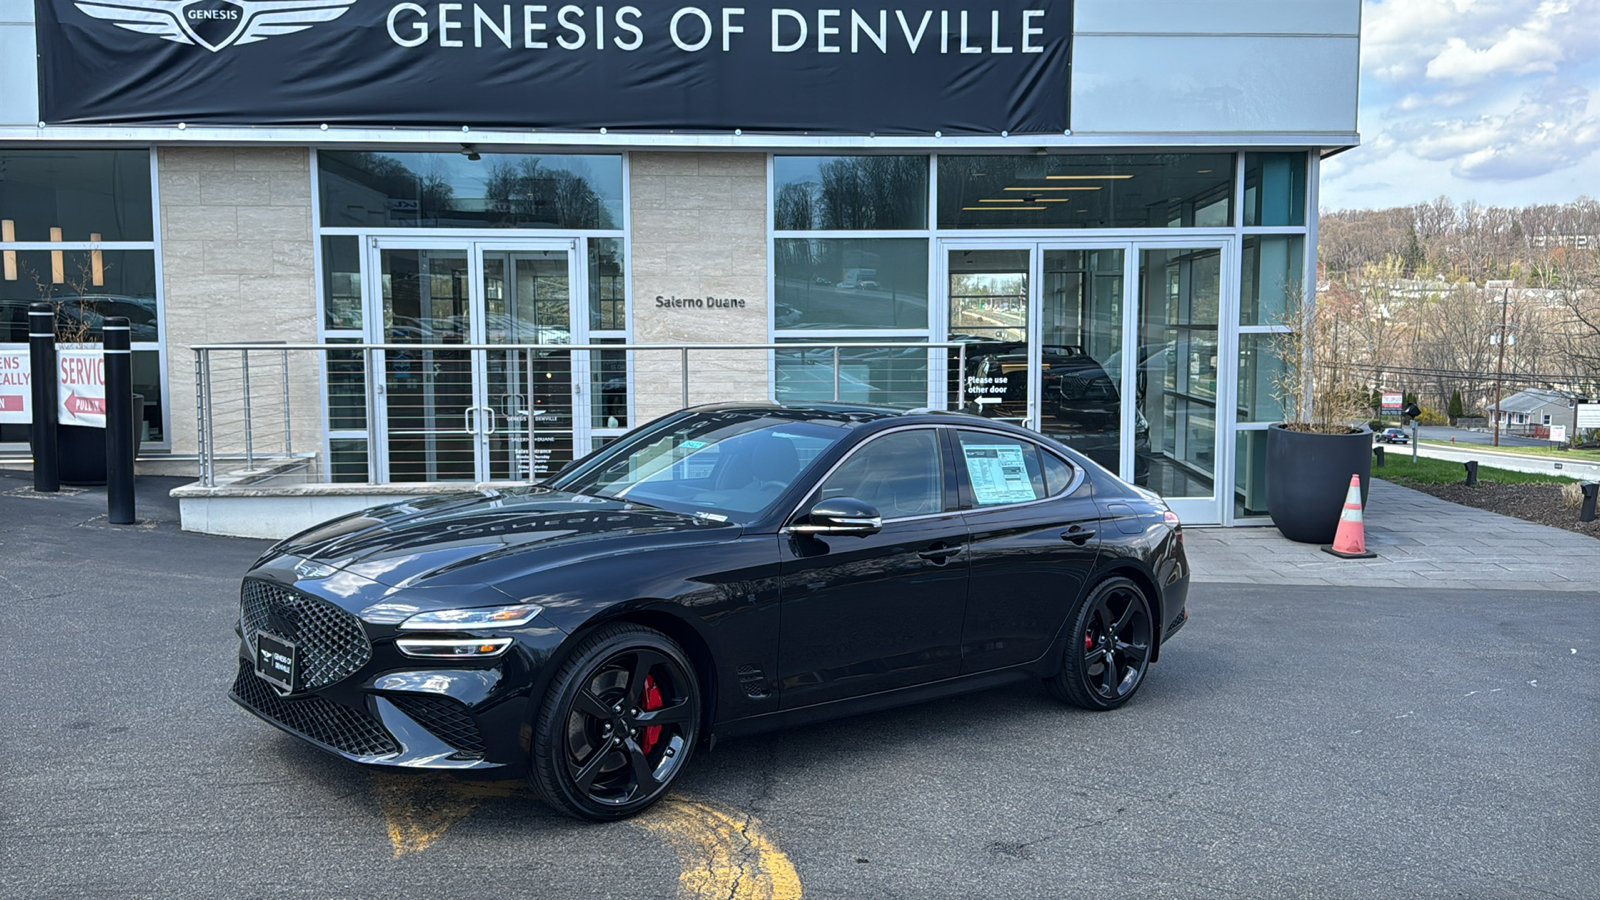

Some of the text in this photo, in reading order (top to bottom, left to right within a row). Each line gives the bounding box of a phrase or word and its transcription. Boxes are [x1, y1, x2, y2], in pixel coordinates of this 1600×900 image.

[187, 10, 238, 20] GENESIS
[386, 2, 1045, 54] GENESIS OF DENVILLE
[655, 296, 746, 308] Salerno Duane
[968, 376, 993, 384] Please
[968, 385, 1008, 394] other door
[75, 398, 92, 412] PULL
